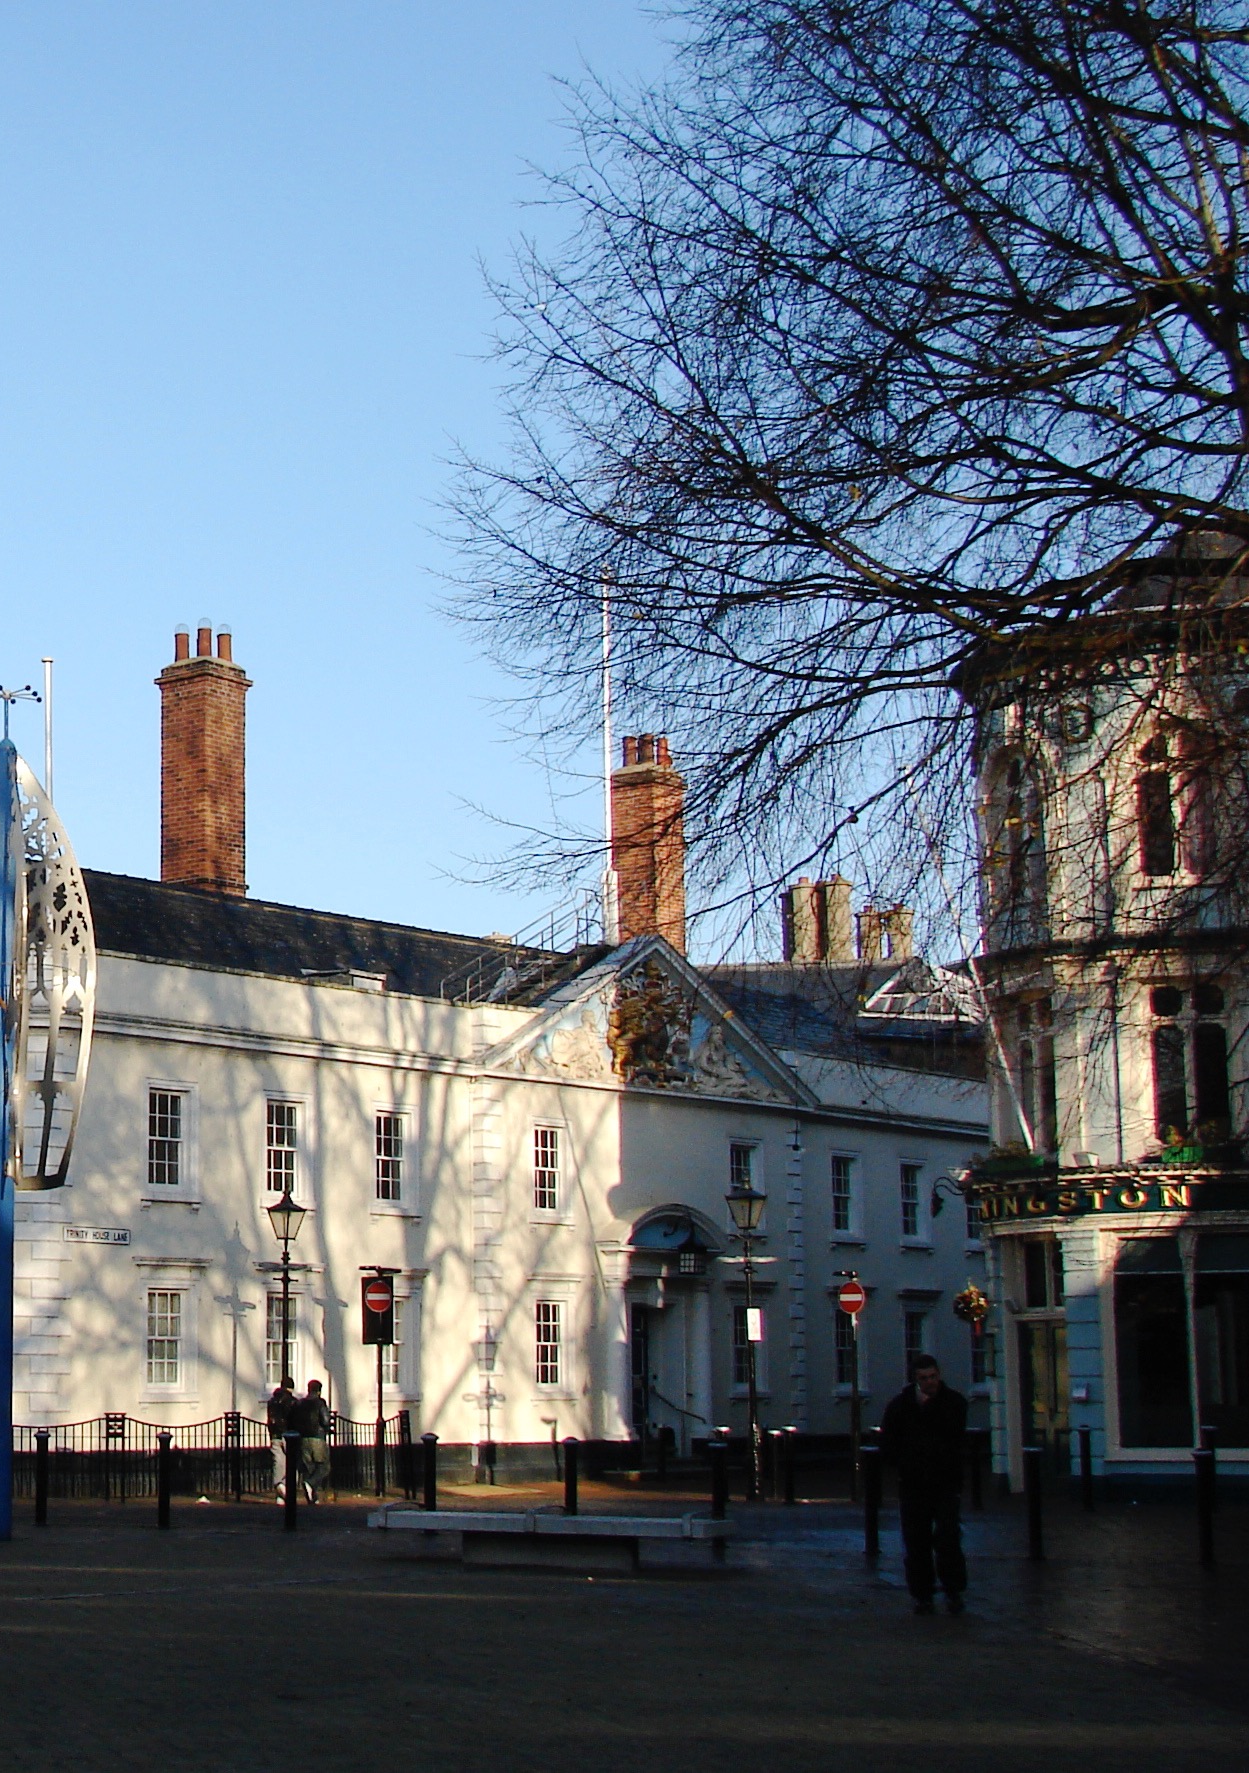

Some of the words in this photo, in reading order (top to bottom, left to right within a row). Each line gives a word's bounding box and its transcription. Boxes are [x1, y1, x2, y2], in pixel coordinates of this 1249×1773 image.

[66, 1229, 88, 1239] TRINITY
[92, 1231, 110, 1240] HOUSE
[113, 1232, 129, 1241] LANE
